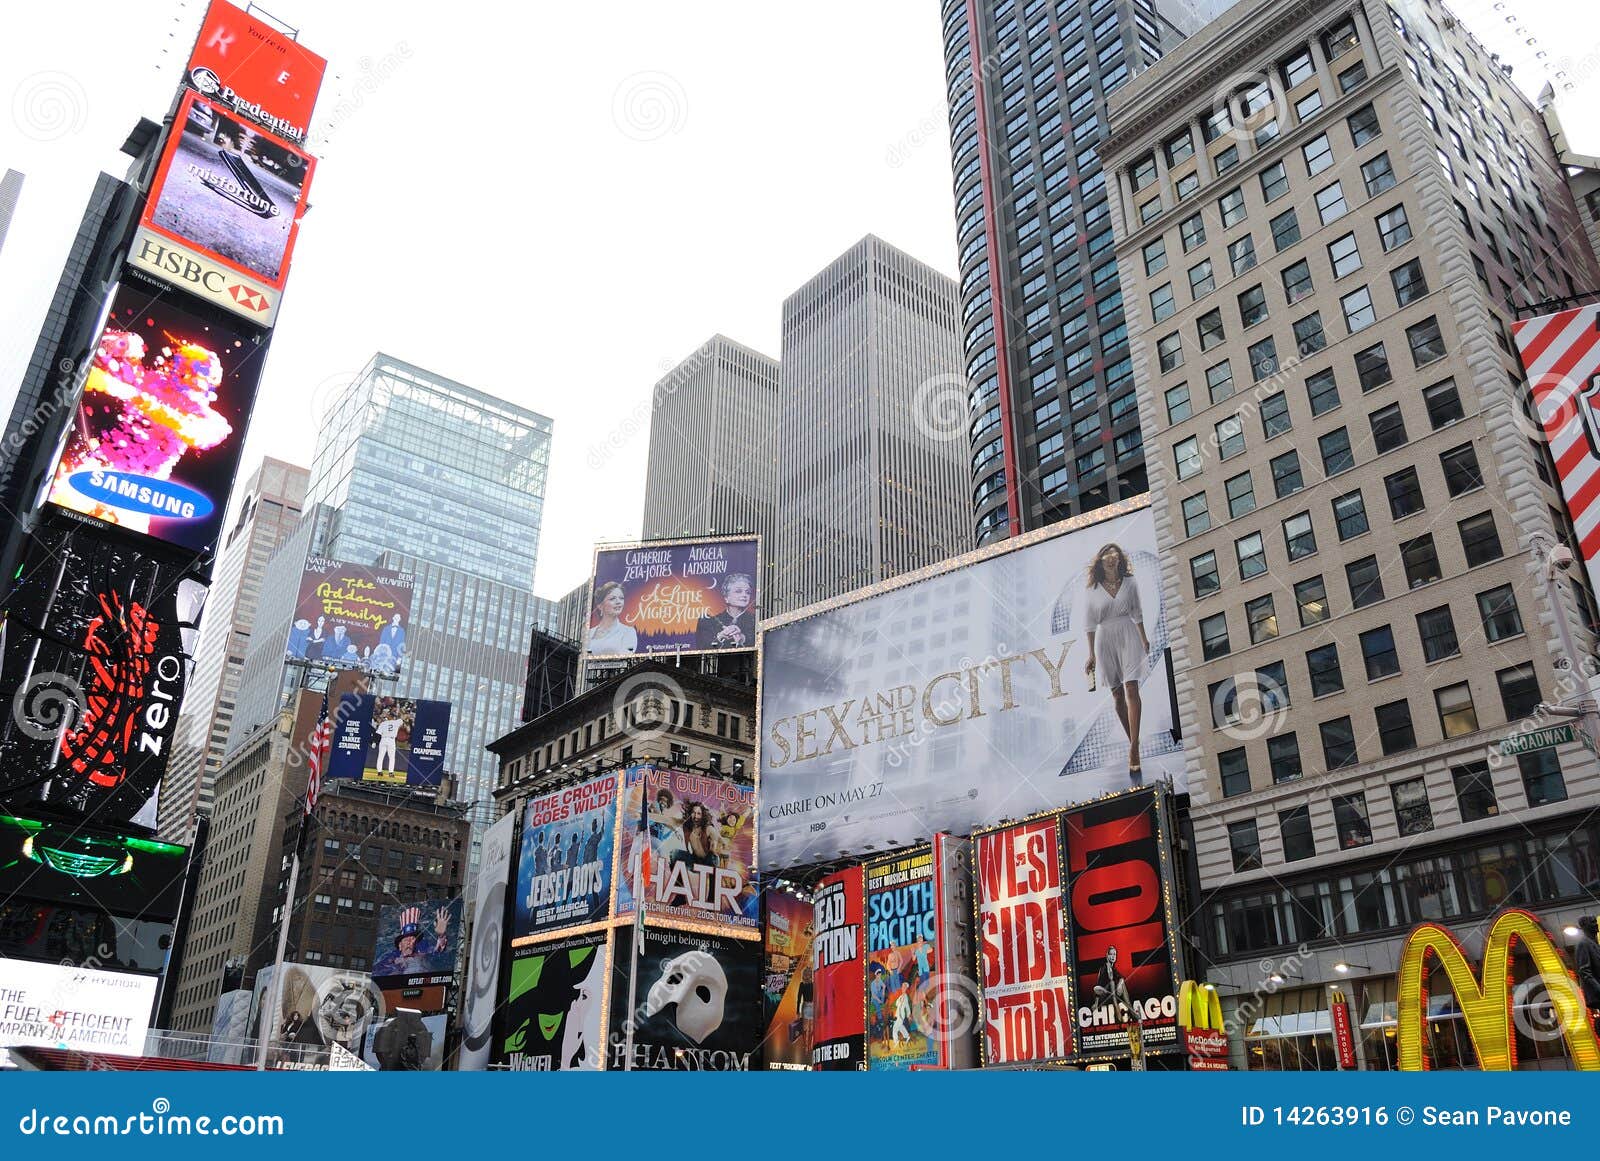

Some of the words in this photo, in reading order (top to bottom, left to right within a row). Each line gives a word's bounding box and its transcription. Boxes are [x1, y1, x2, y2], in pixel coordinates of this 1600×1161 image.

[277, 71, 290, 85] E
[223, 86, 305, 139] Prudential
[187, 162, 280, 216] misfortune
[137, 238, 226, 293] HSBC
[88, 469, 196, 519] SAMSUNG
[305, 556, 342, 569] NATHAN
[625, 549, 672, 567] CATHERINE
[689, 546, 723, 562] ANGELA
[624, 562, 673, 582] ZETA-JONES
[683, 560, 728, 578] LANSBURY
[316, 582, 395, 609] Addams
[341, 577, 377, 590] The
[321, 598, 388, 630] Family
[922, 639, 1077, 727] CITY
[140, 655, 181, 757] zero
[856, 684, 917, 721] AND
[425, 728, 437, 736] THE
[769, 698, 859, 769] SEX
[856, 709, 916, 745] THE
[1504, 727, 1568, 754] BROADWAY
[563, 776, 615, 805] CROWD
[628, 768, 671, 788] LOVE
[676, 775, 713, 797] OUT
[769, 797, 811, 819] CARRIE
[815, 794, 836, 808] ON
[837, 787, 865, 806] MAY
[869, 782, 884, 798] 27
[532, 805, 570, 828] GOES
[810, 822, 826, 832] HBO
[977, 818, 1061, 904] WEST
[526, 865, 570, 909] JERSEY
[571, 860, 604, 898] BOYS
[633, 853, 743, 916] HAIR
[868, 877, 883, 890] BEST
[536, 907, 555, 918] BEST
[556, 900, 589, 914] MUSICAL
[665, 906, 692, 917] REVIVAL
[869, 881, 935, 923] SOUTH
[1065, 813, 1166, 993] HOT
[644, 929, 677, 944] Tonight
[678, 933, 710, 948] belongs
[869, 911, 936, 952] PACIFIC
[981, 895, 1067, 989] SIDE
[1, 988, 26, 1004] THE
[984, 987, 1074, 1064] STORY
[1078, 995, 1176, 1028] CHICAGO
[1336, 1006, 1344, 1028] OPEN
[50, 1026, 66, 1040] IN
[611, 1043, 751, 1071] PHANTOM
[821, 1045, 832, 1061] THE
[833, 1042, 849, 1060] END
[1341, 1037, 1349, 1064] HOURS
